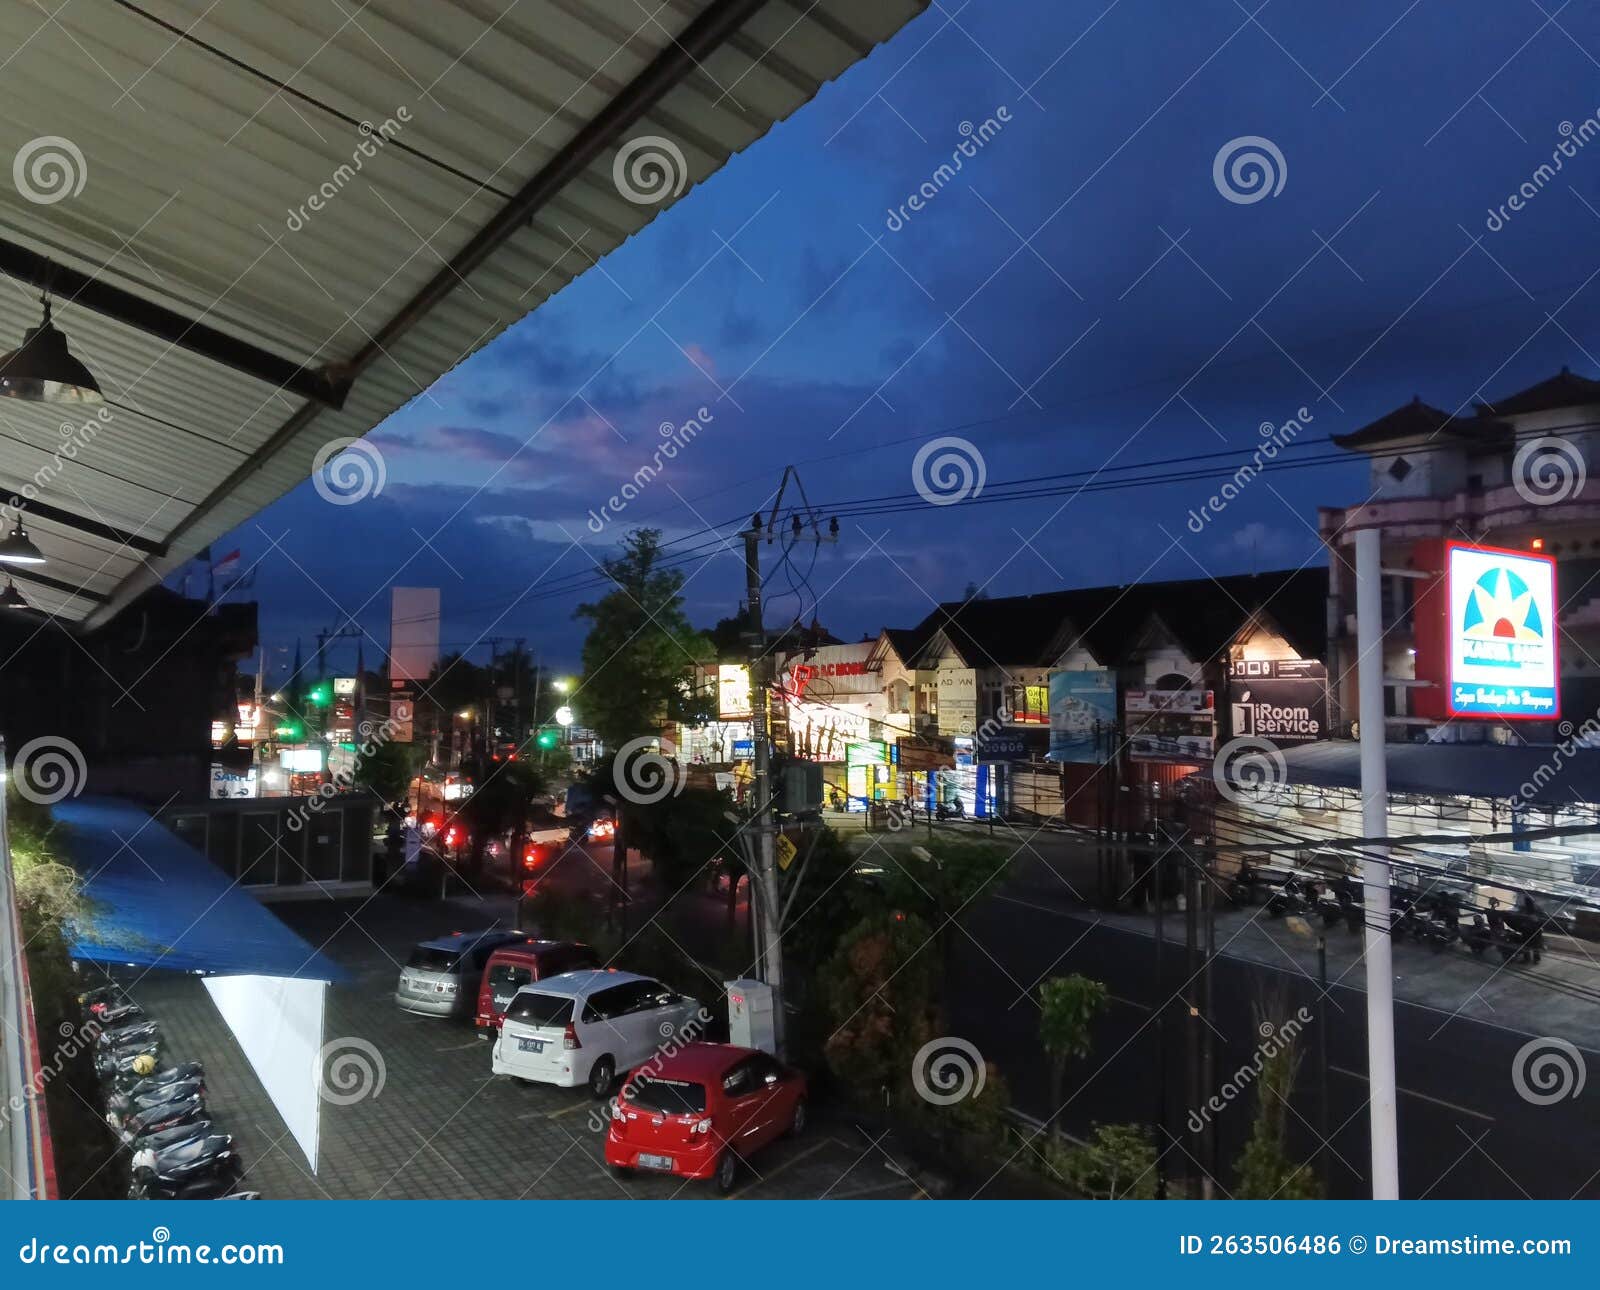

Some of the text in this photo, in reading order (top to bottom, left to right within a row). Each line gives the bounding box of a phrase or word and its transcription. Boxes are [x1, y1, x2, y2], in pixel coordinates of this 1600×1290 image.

[941, 679, 973, 687] ADAN
[1255, 703, 1310, 721] iRoom
[1256, 719, 1320, 734] service
